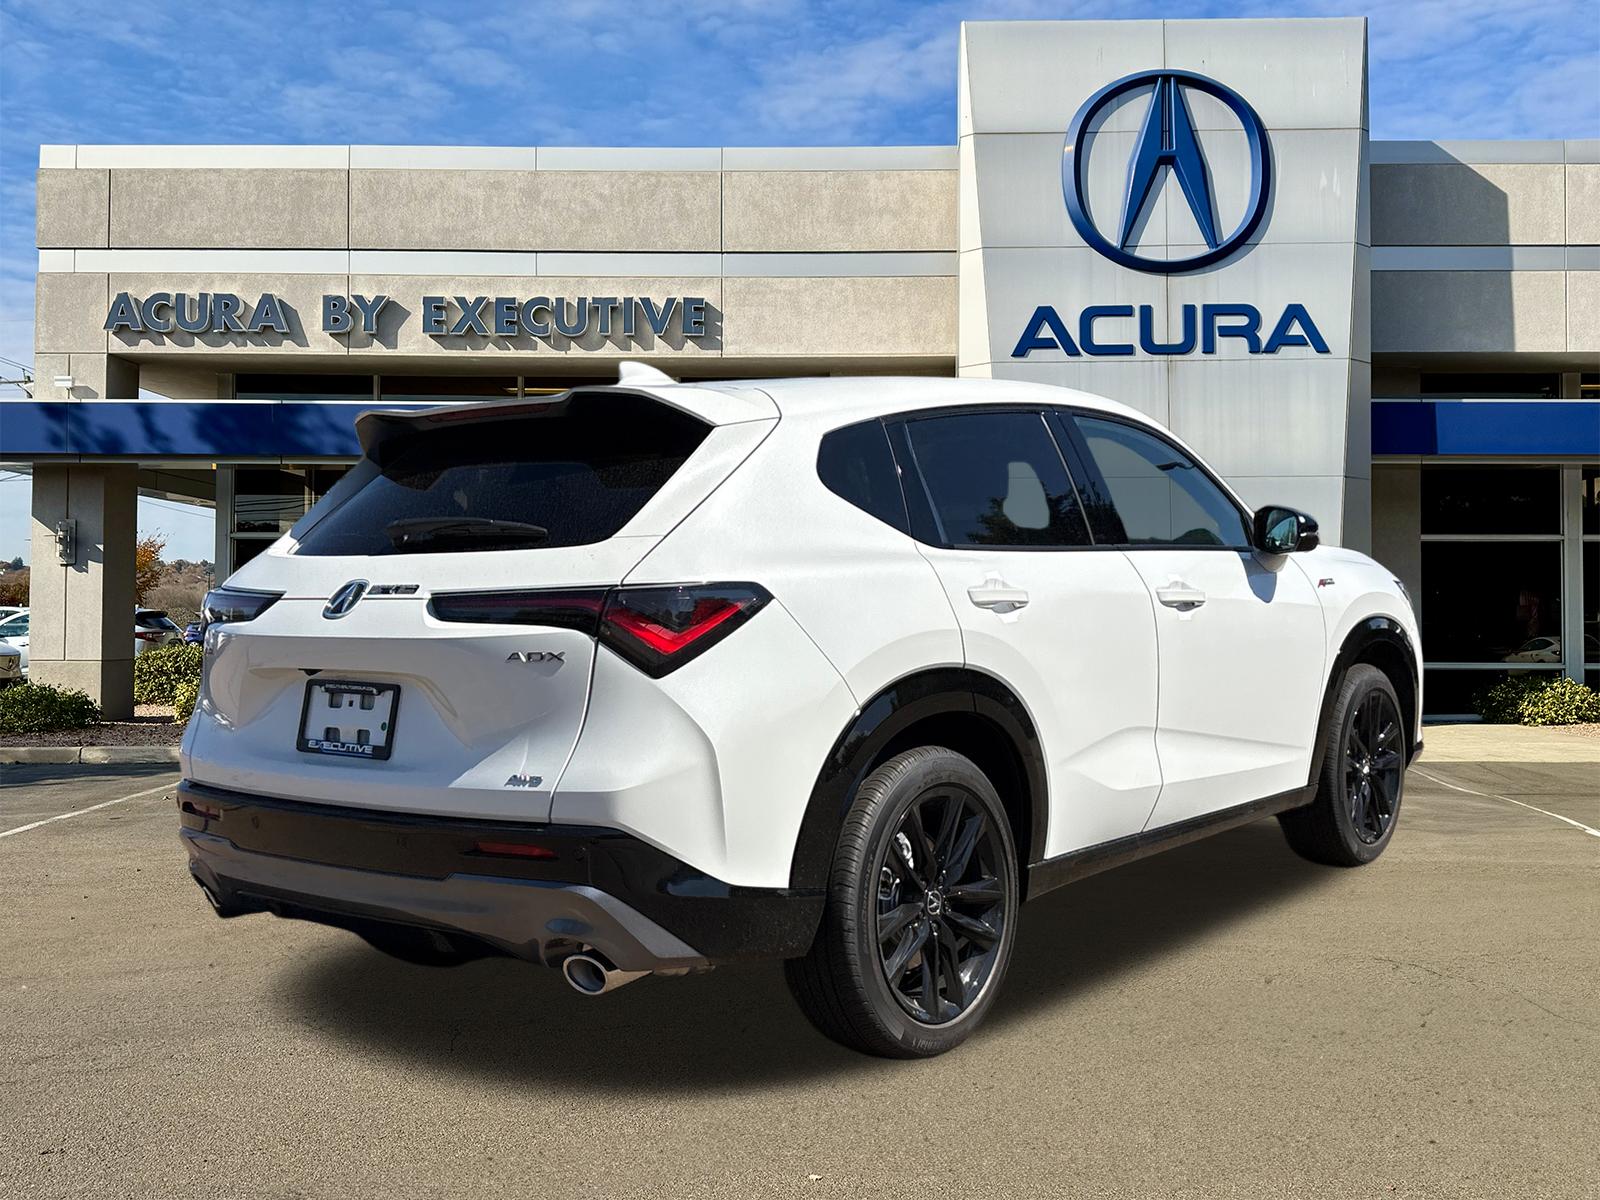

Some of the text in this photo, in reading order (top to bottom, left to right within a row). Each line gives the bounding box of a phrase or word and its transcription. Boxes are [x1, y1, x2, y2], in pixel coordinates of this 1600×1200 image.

[103, 291, 707, 337] ACURA BY EXECUTIVE
[1010, 303, 1332, 358] ACURA
[506, 651, 566, 663] ADX
[308, 739, 374, 754] EXECUTIVE
